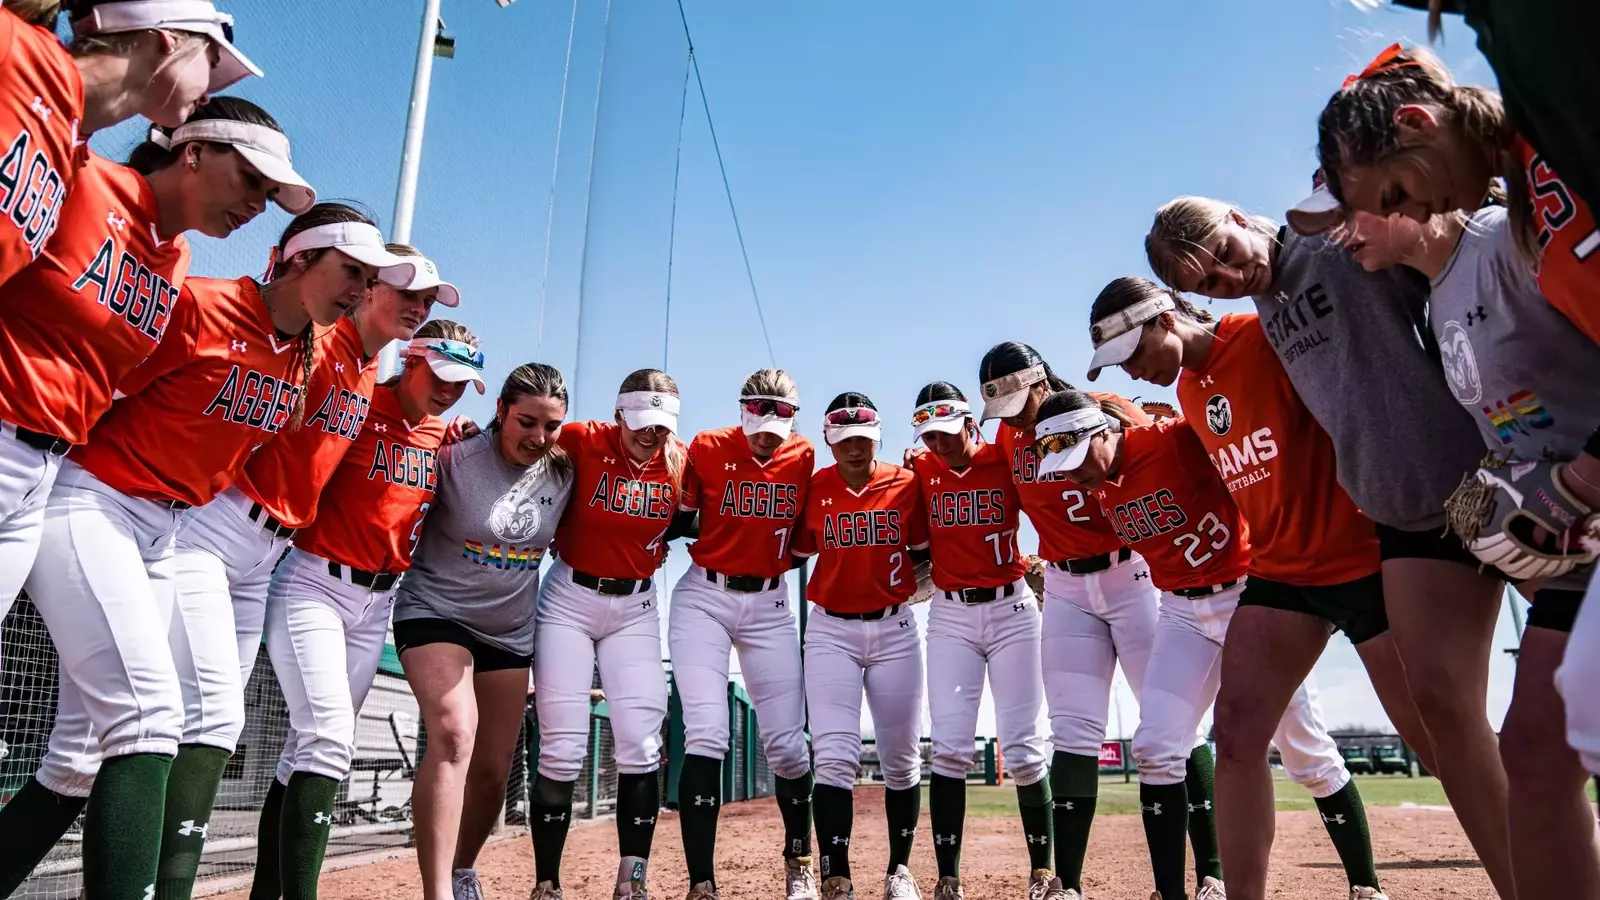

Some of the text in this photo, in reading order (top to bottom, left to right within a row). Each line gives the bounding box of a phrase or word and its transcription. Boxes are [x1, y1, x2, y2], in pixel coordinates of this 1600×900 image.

[1266, 282, 1334, 349] STATE
[367, 439, 437, 494] AGGIE
[589, 471, 673, 519] AGGIES
[720, 479, 798, 519] AGGIES
[929, 488, 1005, 528] AGGIES
[1061, 489, 1092, 522] 2
[823, 510, 901, 549] AGGIES
[1173, 511, 1231, 568] 23
[462, 539, 544, 571] RAMS
[889, 551, 903, 587] 2
